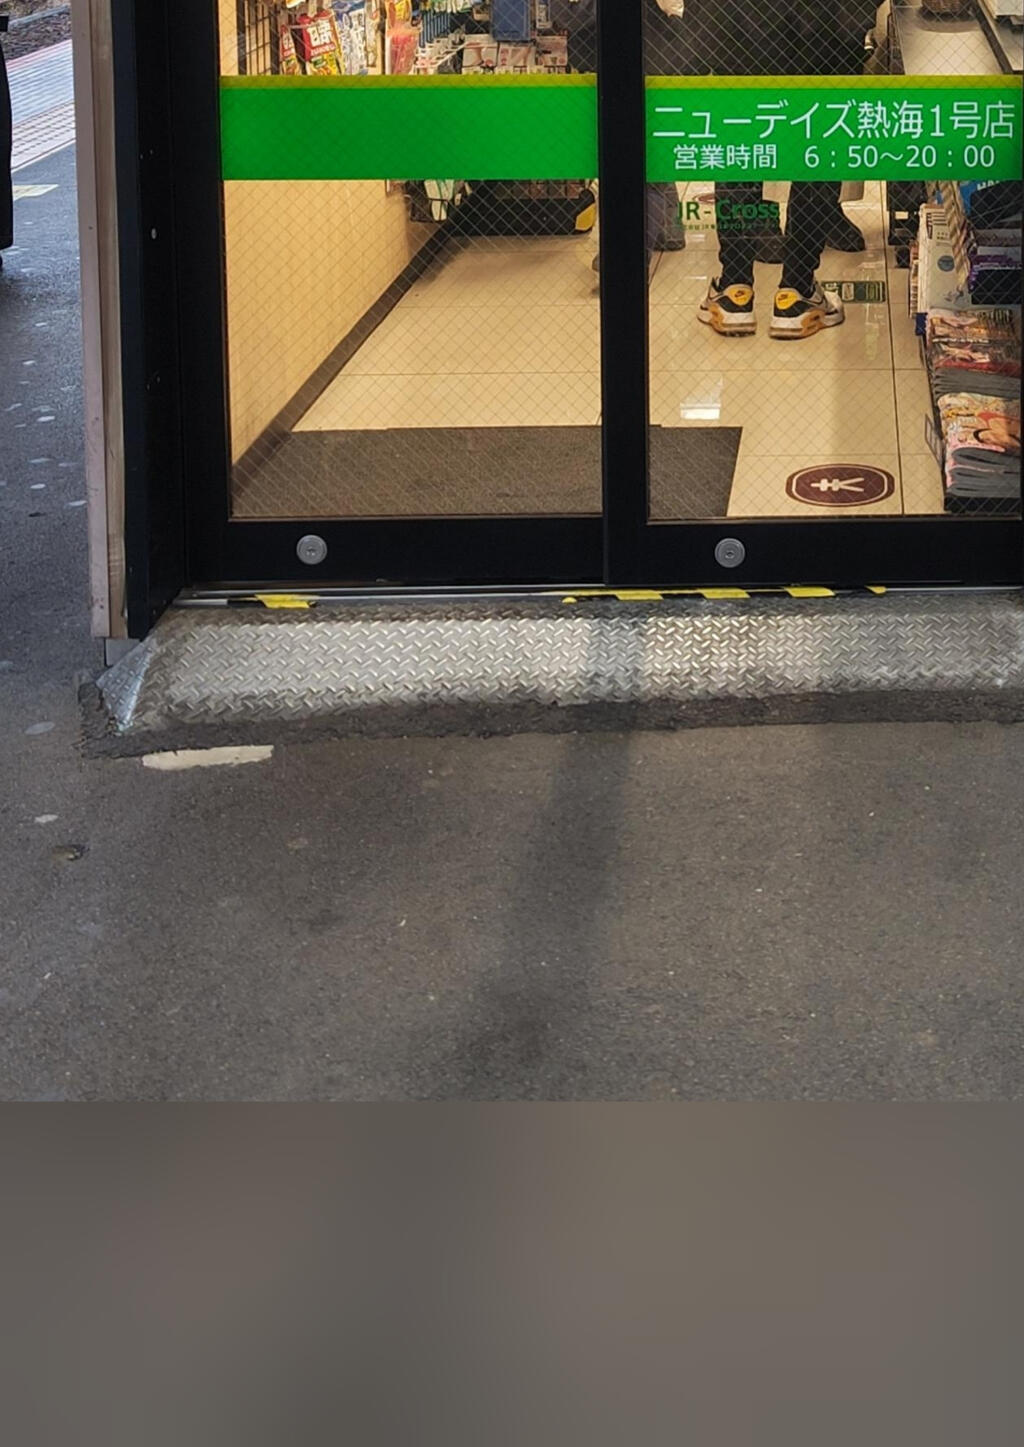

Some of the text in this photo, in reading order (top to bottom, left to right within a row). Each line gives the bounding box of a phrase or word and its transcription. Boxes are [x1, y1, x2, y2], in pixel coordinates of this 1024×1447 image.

[652, 99, 1015, 140] ニューデイズ熱海1号店
[673, 143, 778, 170] 営業時間
